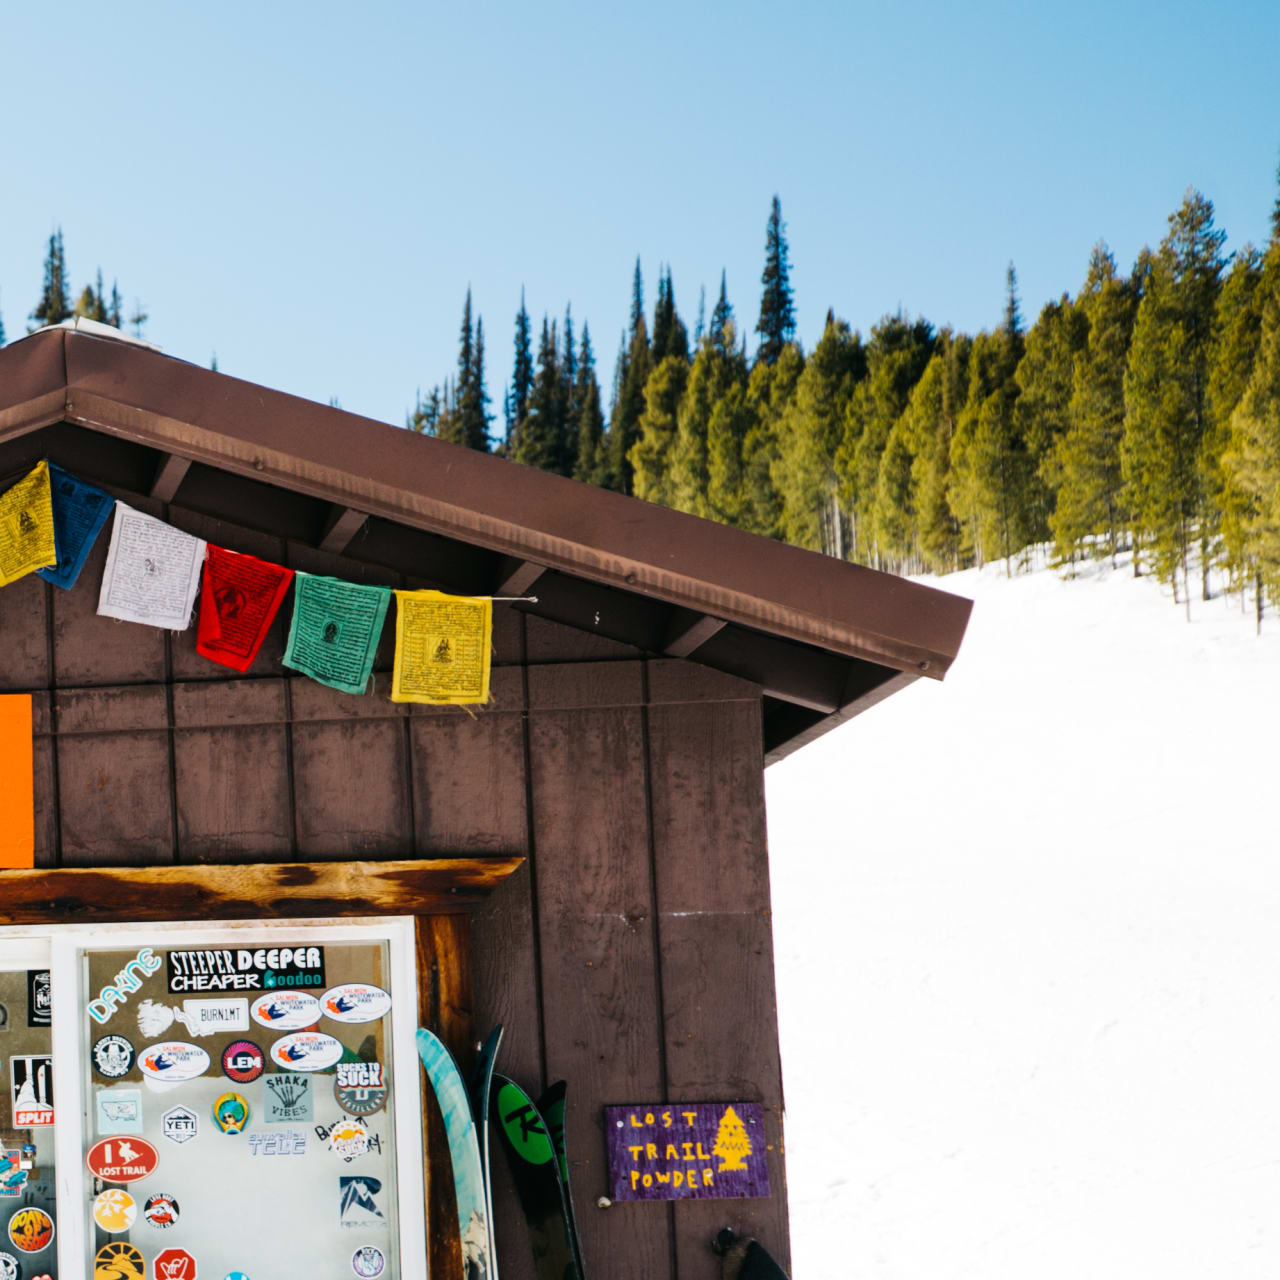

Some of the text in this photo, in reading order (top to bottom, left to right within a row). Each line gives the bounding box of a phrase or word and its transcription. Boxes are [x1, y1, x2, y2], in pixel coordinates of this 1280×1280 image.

[170, 947, 321, 975] STEEPER DEEPER
[171, 974, 261, 991] CHEAPER
[227, 1057, 261, 1069] LEM
[267, 1076, 308, 1089] SHAKA
[337, 1071, 381, 1086] SUCK
[17, 1111, 53, 1124] SPLIT
[272, 1105, 308, 1117] VIBES
[167, 1121, 194, 1130] YETI
[630, 1111, 697, 1128] LOST
[104, 1143, 112, 1164] I
[628, 1142, 710, 1161] TRAIL
[99, 1166, 147, 1176] LOST TRAIL
[630, 1168, 714, 1191] POWDER
